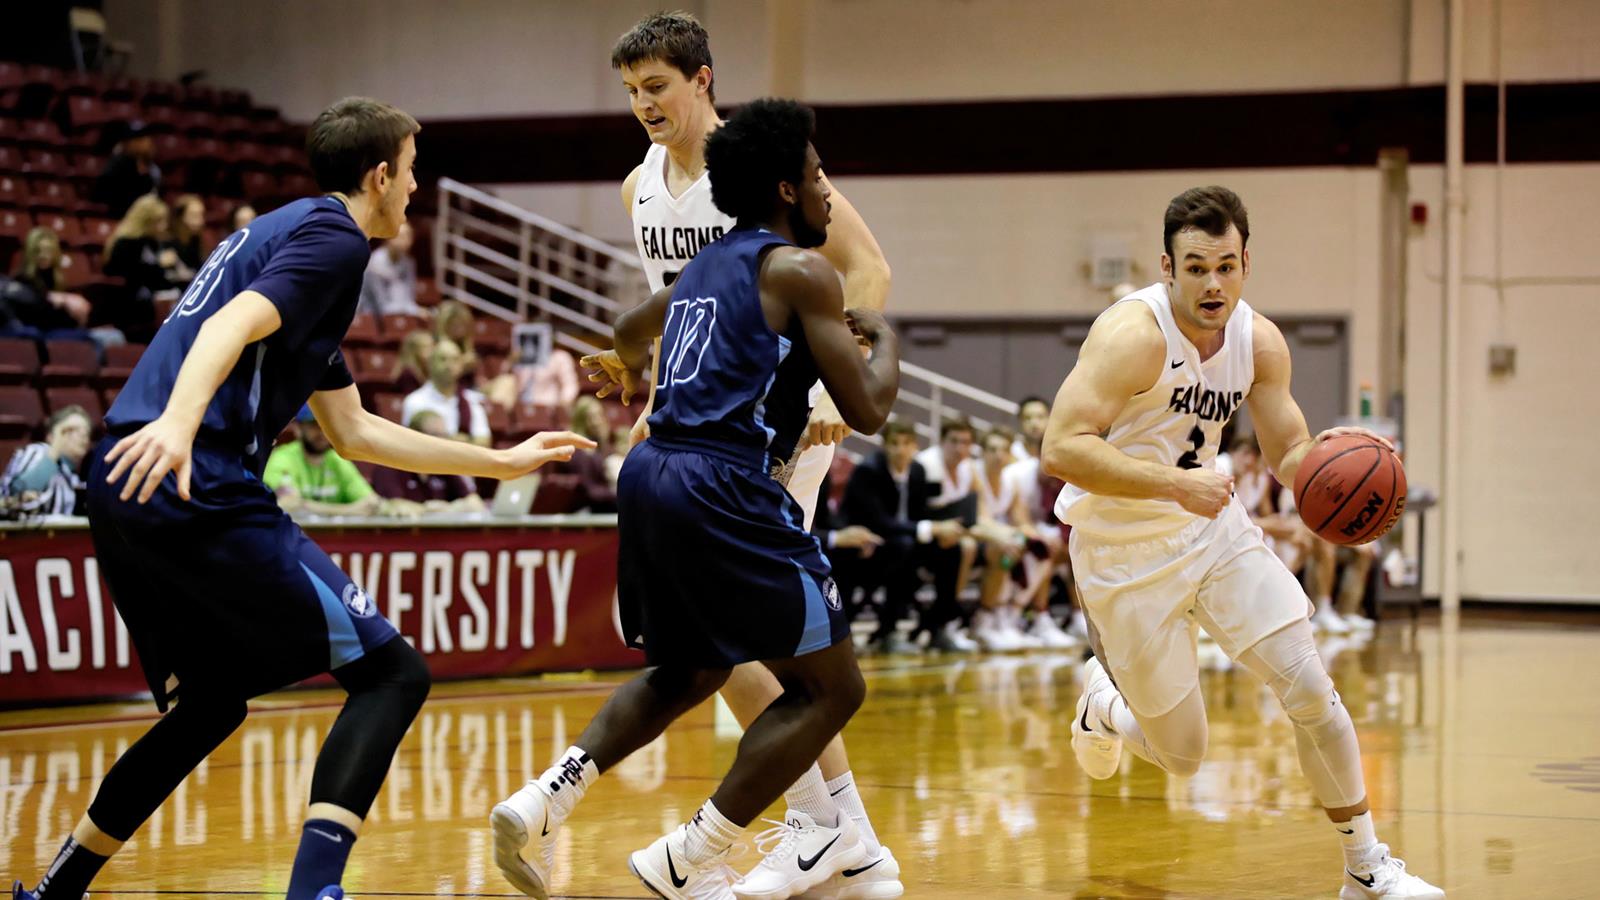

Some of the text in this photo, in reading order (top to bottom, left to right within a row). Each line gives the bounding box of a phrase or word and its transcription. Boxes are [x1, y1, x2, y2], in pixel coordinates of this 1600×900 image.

[1176, 424, 1205, 470] 2
[1341, 491, 1384, 536] NCAA
[332, 549, 577, 653] VERSITY
